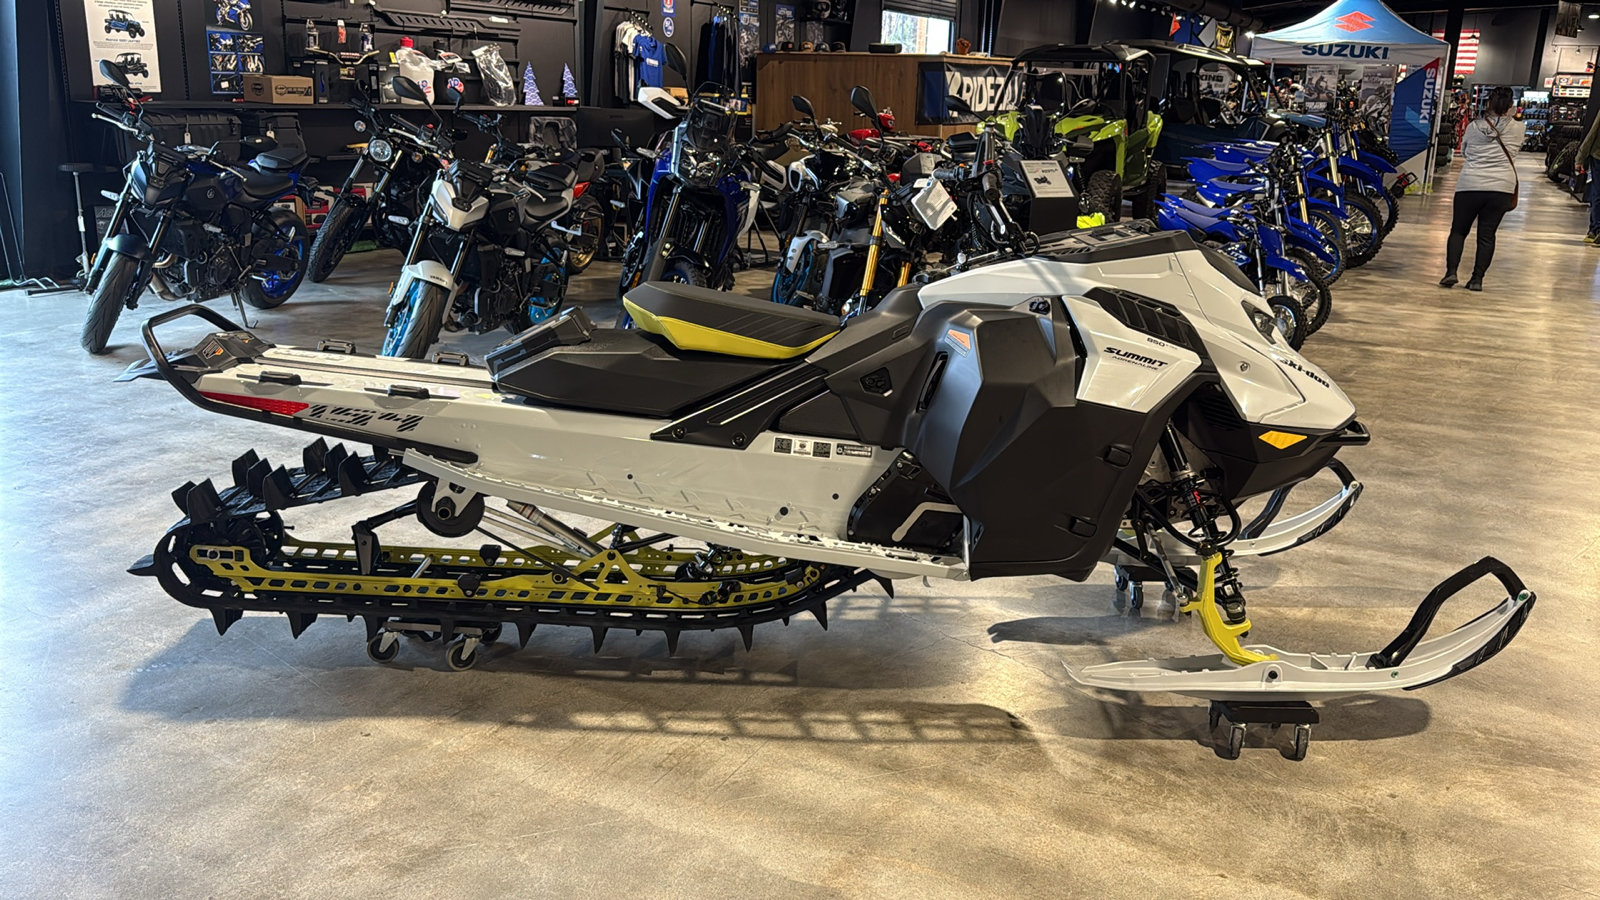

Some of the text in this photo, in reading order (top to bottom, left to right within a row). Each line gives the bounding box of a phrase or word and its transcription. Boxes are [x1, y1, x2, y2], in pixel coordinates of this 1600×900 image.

[1301, 44, 1389, 59] SUZUKI
[1419, 67, 1436, 124] SUZUKI
[1147, 337, 1165, 347] 850
[1103, 346, 1168, 367] SUMMIT
[1111, 356, 1159, 371] ADRENALINE
